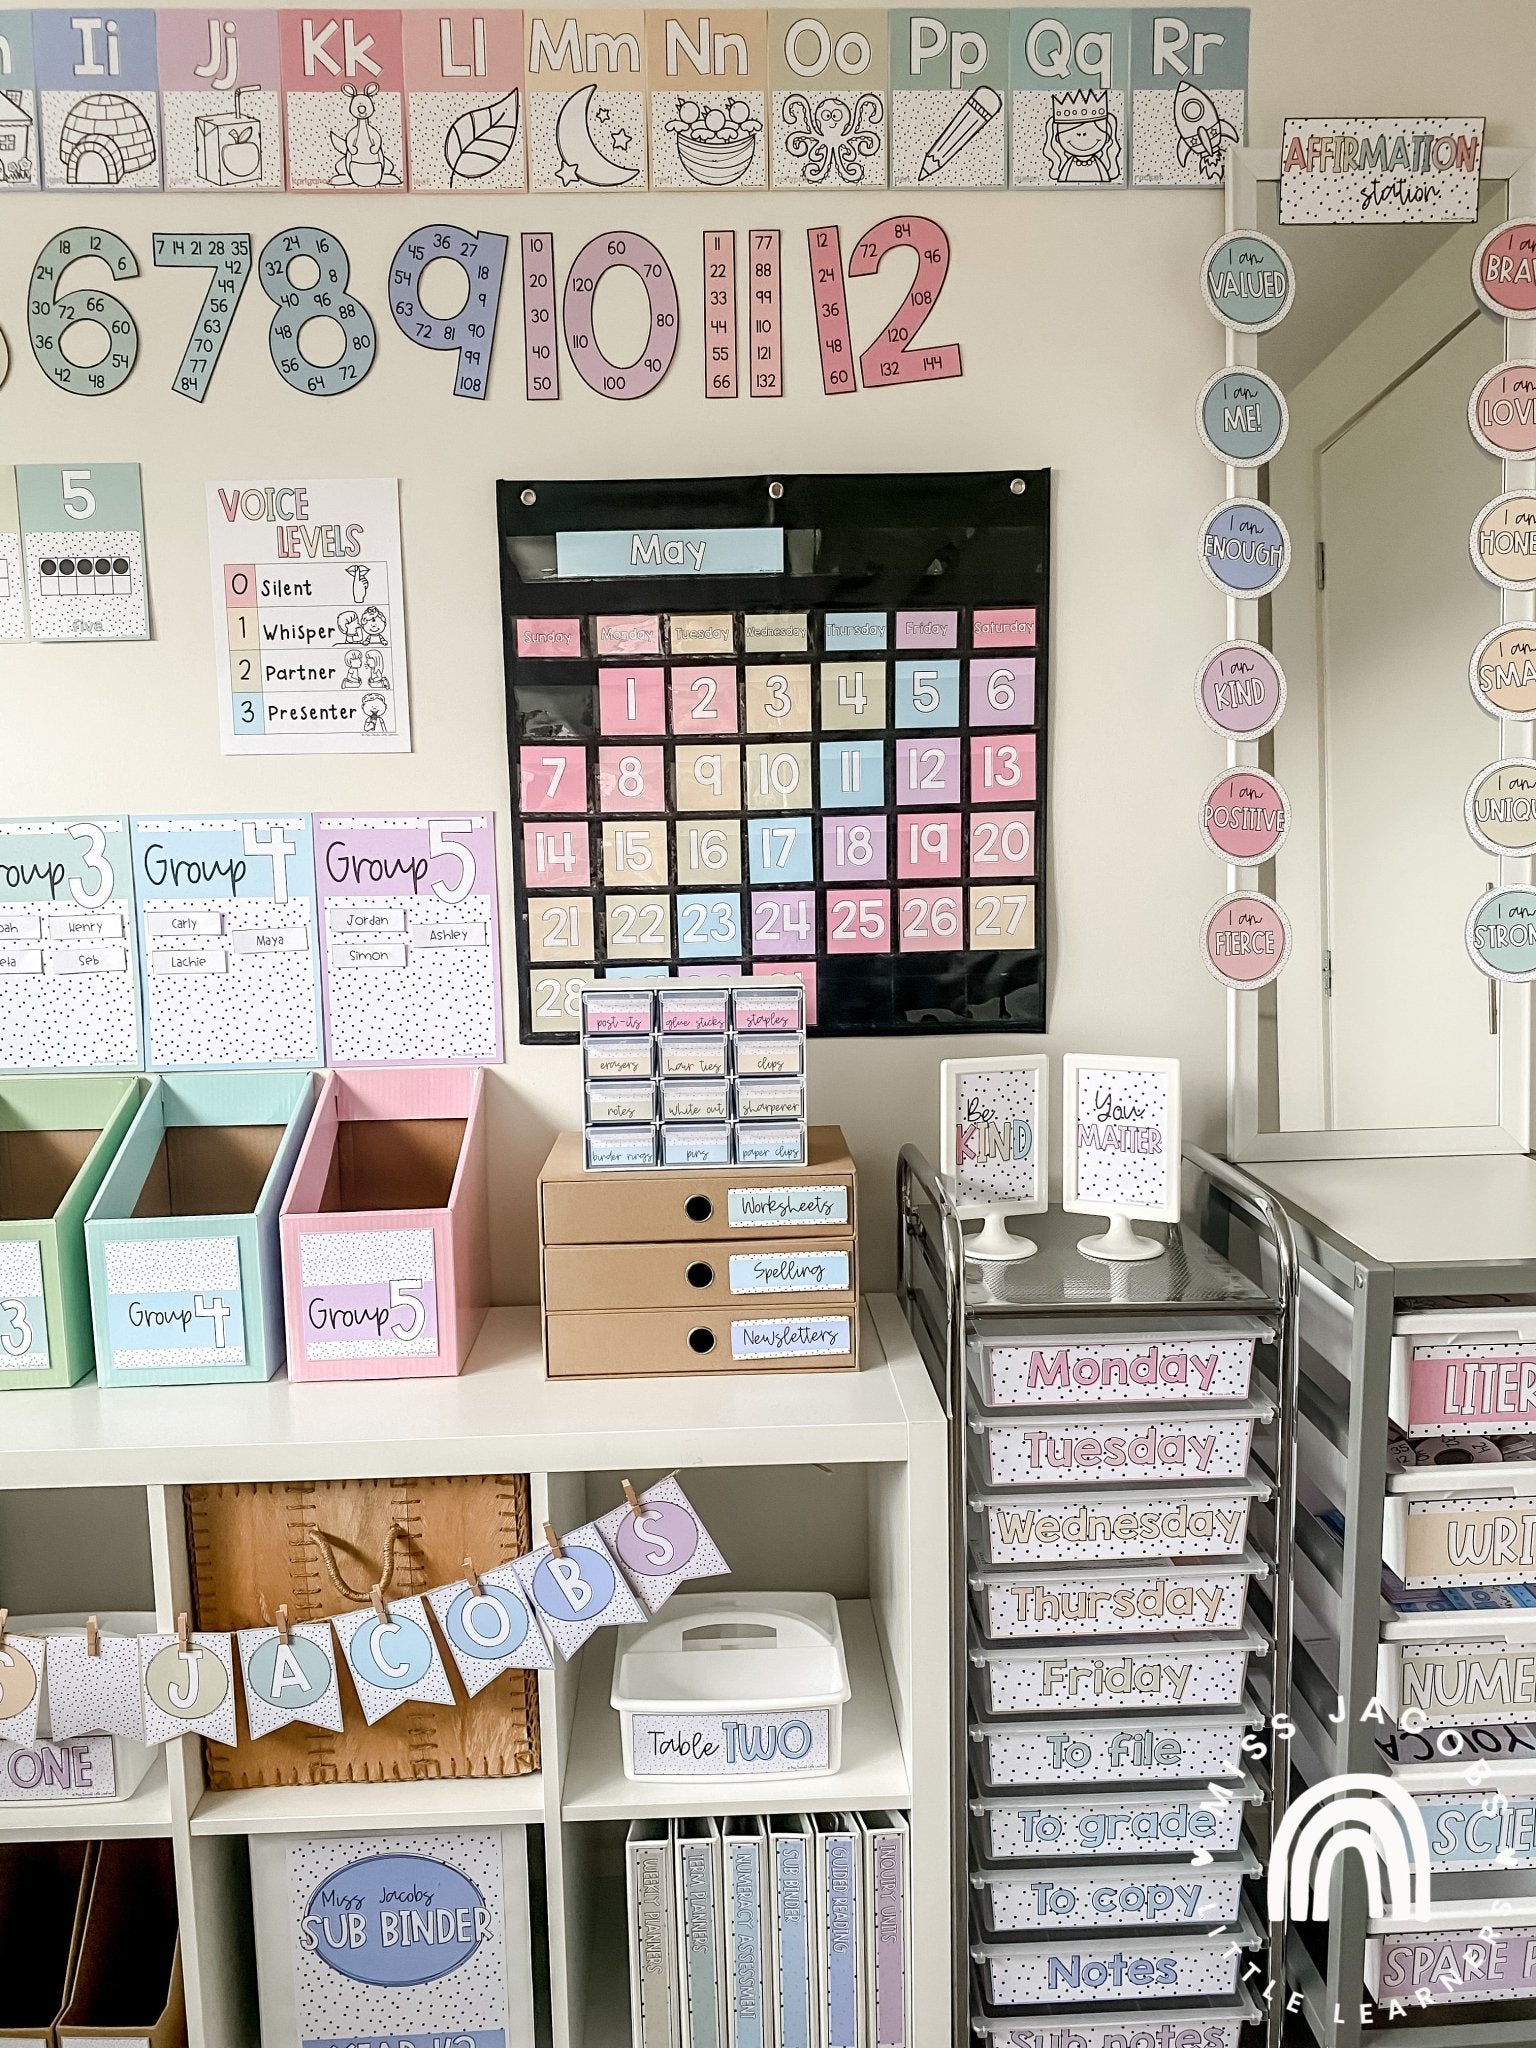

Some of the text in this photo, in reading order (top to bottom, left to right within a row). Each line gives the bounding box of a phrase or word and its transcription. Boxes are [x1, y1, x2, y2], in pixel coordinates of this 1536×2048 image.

[71, 17, 120, 76] Ii
[193, 19, 240, 90] Jj
[302, 19, 383, 77] Kk
[439, 18, 486, 77] Ll
[529, 19, 640, 73] Mm
[665, 17, 748, 76] Nn
[784, 18, 872, 77] Oo
[909, 17, 989, 89] Pp
[1025, 18, 1112, 89] Qq
[1153, 17, 1226, 76] Rr
[1284, 134, 1478, 174] AFFIRMATION
[1360, 177, 1441, 209] station
[156, 241, 247, 256] 7 14 21 28 35
[225, 261, 241, 274] 42
[1208, 271, 1286, 298] VALUED
[218, 280, 234, 293] 49
[210, 299, 227, 312] 56
[204, 320, 221, 333] 63
[194, 339, 213, 352] 70
[181, 377, 197, 390] 84
[190, 360, 206, 373] 77
[1223, 403, 1262, 433] ME!
[61, 470, 96, 520] 5
[218, 487, 309, 522] VOICE
[277, 524, 364, 558] LEVELS
[630, 534, 707, 571] May
[1203, 533, 1284, 568] ENOUGH
[232, 573, 312, 597] 0 Silent
[72, 618, 103, 633] five
[238, 616, 335, 644] 1 Whisper
[524, 621, 1035, 644] Sunday Monday Tuesday Wednesday Thursday Friday Saturday
[239, 659, 336, 681] 2 Partner
[627, 678, 637, 720] 1
[690, 677, 718, 719] 2
[764, 675, 791, 718] 3
[838, 672, 867, 714] 4
[913, 671, 940, 713] 5
[987, 669, 1016, 711] 6
[1213, 678, 1266, 711] KIND
[240, 700, 357, 724] 3 Presenter
[540, 757, 567, 799] 7
[618, 756, 645, 798] 8
[694, 754, 722, 796] 9
[760, 753, 800, 795] 10
[841, 751, 860, 792] 11
[909, 748, 946, 789] 12
[984, 745, 1022, 788] 13
[1203, 804, 1285, 834] POSITIVE
[68, 822, 114, 909] 3
[144, 822, 296, 904] Group 4
[326, 819, 477, 904] Group 5
[69, 922, 102, 933] Henry
[172, 919, 197, 931] Carly
[347, 915, 389, 926] Jordan
[430, 930, 467, 941] Ashley
[256, 935, 284, 946] Maya
[349, 950, 389, 961] Simon
[1215, 928, 1275, 957] FIERCE
[79, 955, 99, 966] Seb
[171, 957, 207, 968] Lachie
[597, 1017, 642, 1032] post-its
[666, 1017, 725, 1031] glue sticks
[746, 1012, 789, 1027] staples
[600, 1060, 638, 1072] erasers
[667, 1059, 722, 1073] hair ties
[757, 1059, 784, 1071] clips
[607, 1105, 636, 1118] notes
[668, 1103, 725, 1116] white out
[967, 1097, 996, 1124] Be
[1094, 1090, 1146, 1121] You
[686, 1149, 710, 1162] pins
[742, 1145, 799, 1161] paper clips
[955, 1119, 1033, 1166] KIND
[1077, 1123, 1163, 1154] MATTER
[741, 1197, 834, 1217] Worksheets
[753, 1262, 826, 1285] Spelling
[128, 1294, 231, 1348] Group 4
[308, 1278, 426, 1342] Group 5
[743, 1326, 839, 1348] Newsletters
[1027, 1347, 1218, 1391] Monday
[1023, 1426, 1216, 1471] Tuesday
[996, 1505, 1242, 1544] Wednesday
[1011, 1581, 1224, 1623] Thursday
[1042, 1658, 1192, 1699] Friday
[648, 1720, 812, 1764] Table TWO
[1047, 1732, 1181, 1769] To file
[8, 1746, 92, 1789] ONE
[1018, 1804, 1216, 1848] To grade
[322, 1890, 365, 1910] Miss
[688, 1854, 708, 1954] TERM PLANNERS
[782, 1849, 800, 1924] SUB BINDER
[832, 1847, 849, 1953] GUIDED READING
[879, 1845, 897, 1943] INQUIRY UNITS
[1031, 1882, 1201, 1919] To copy
[301, 1907, 494, 1951] SUB BINDER
[643, 1859, 663, 1974] WEEKLY PLANNERS
[736, 1854, 756, 2020] NUMERACY ASSESSMENT
[1048, 1953, 1178, 1989] Notes
[1384, 1942, 1508, 1987] SPARE
